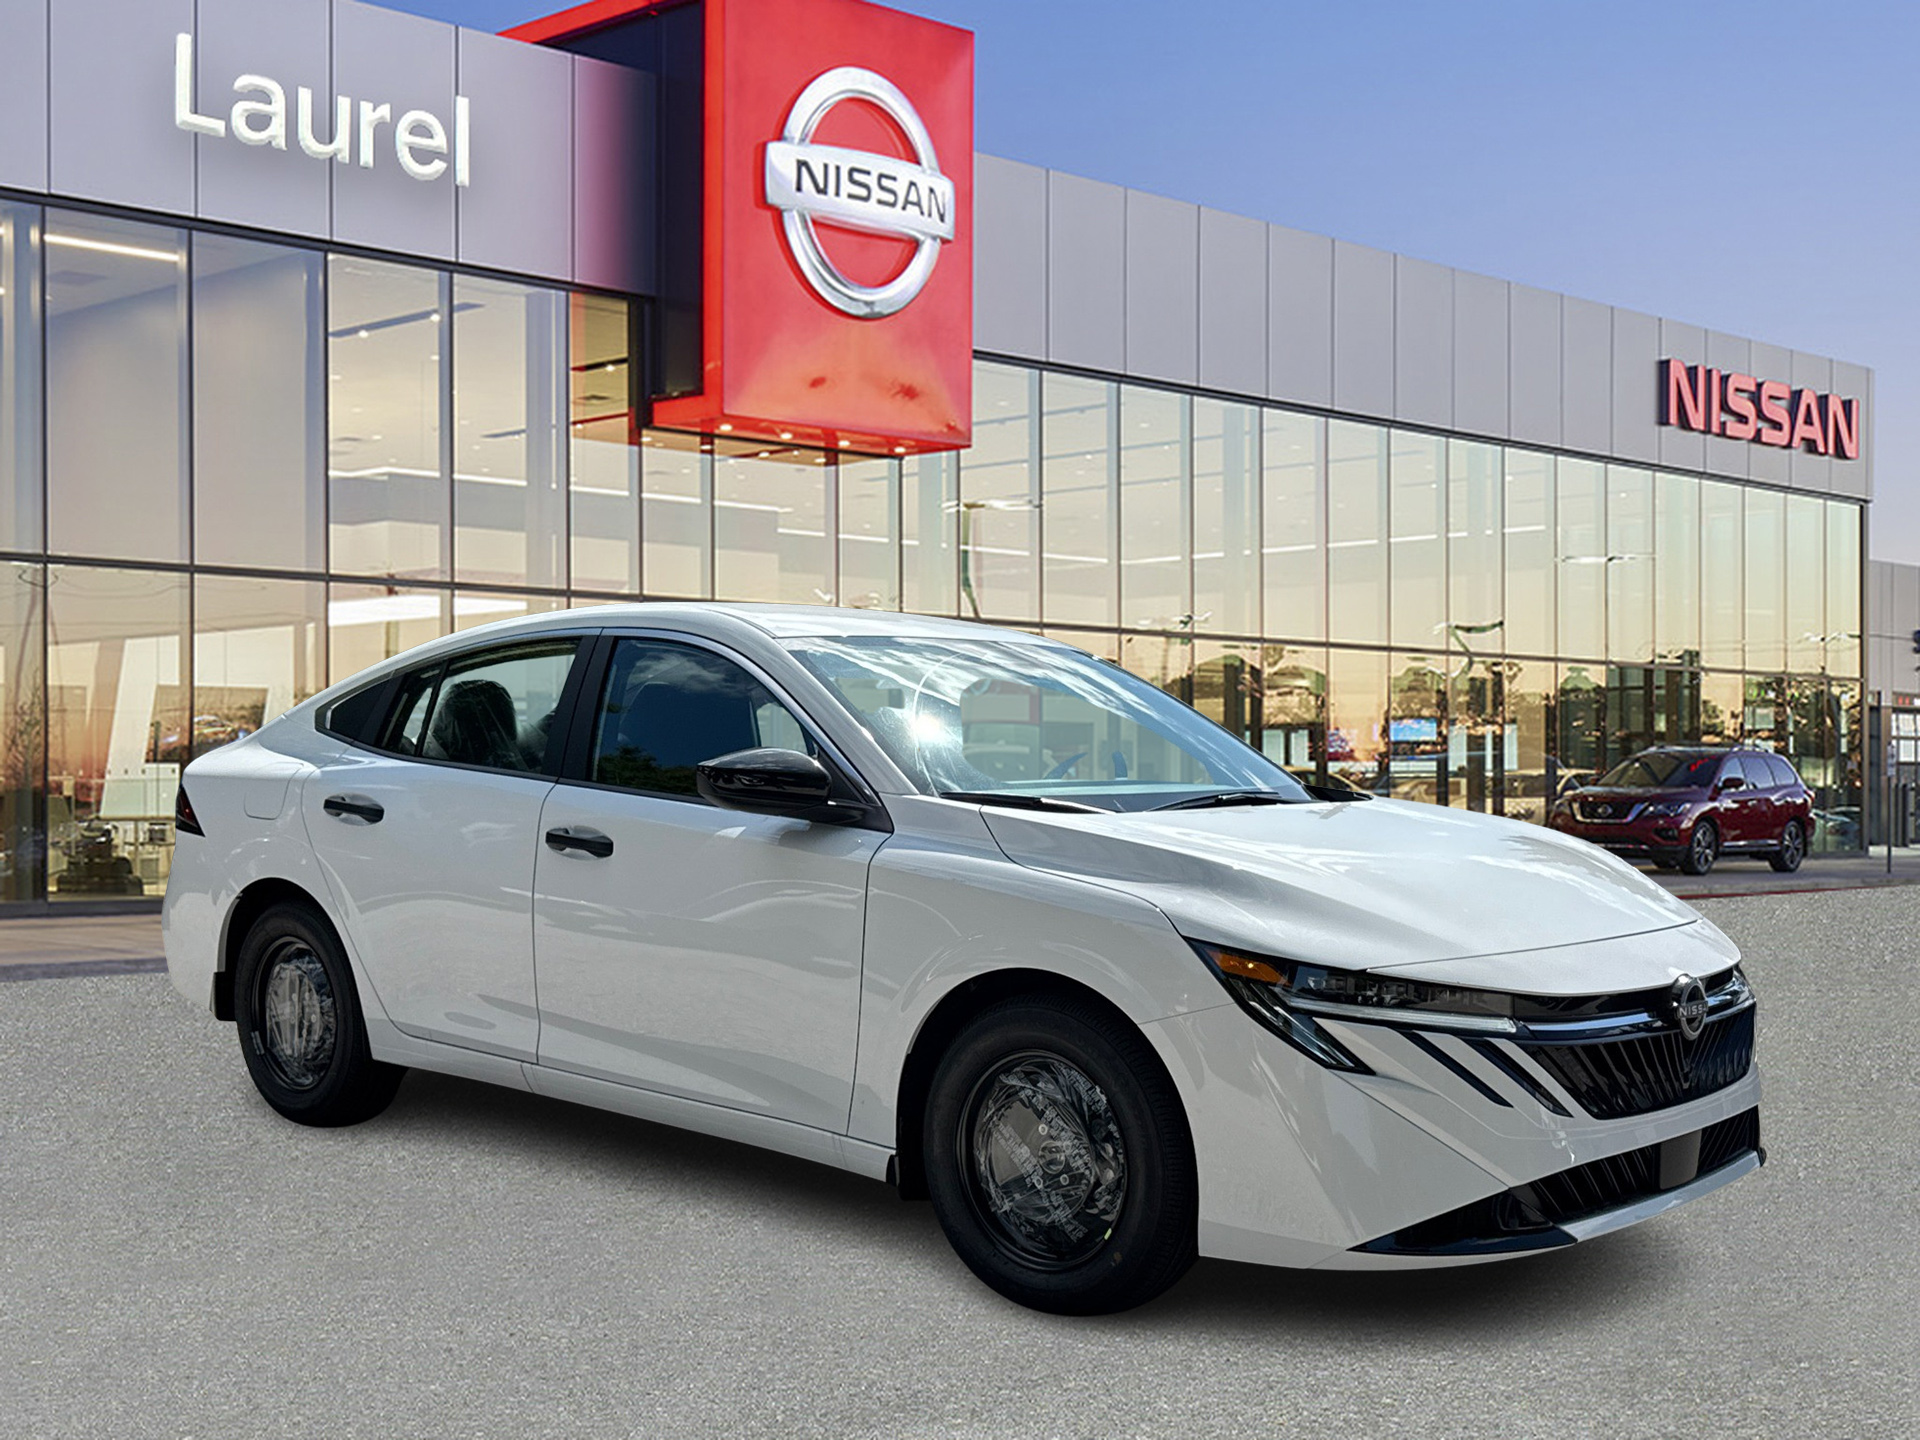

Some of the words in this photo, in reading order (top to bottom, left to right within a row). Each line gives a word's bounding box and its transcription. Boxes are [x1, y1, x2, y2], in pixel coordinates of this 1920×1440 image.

[175, 32, 470, 187] Laurel
[795, 158, 946, 224] NISSAN
[1658, 358, 1860, 460] NISSAN
[1680, 1004, 1708, 1016] NISSA
